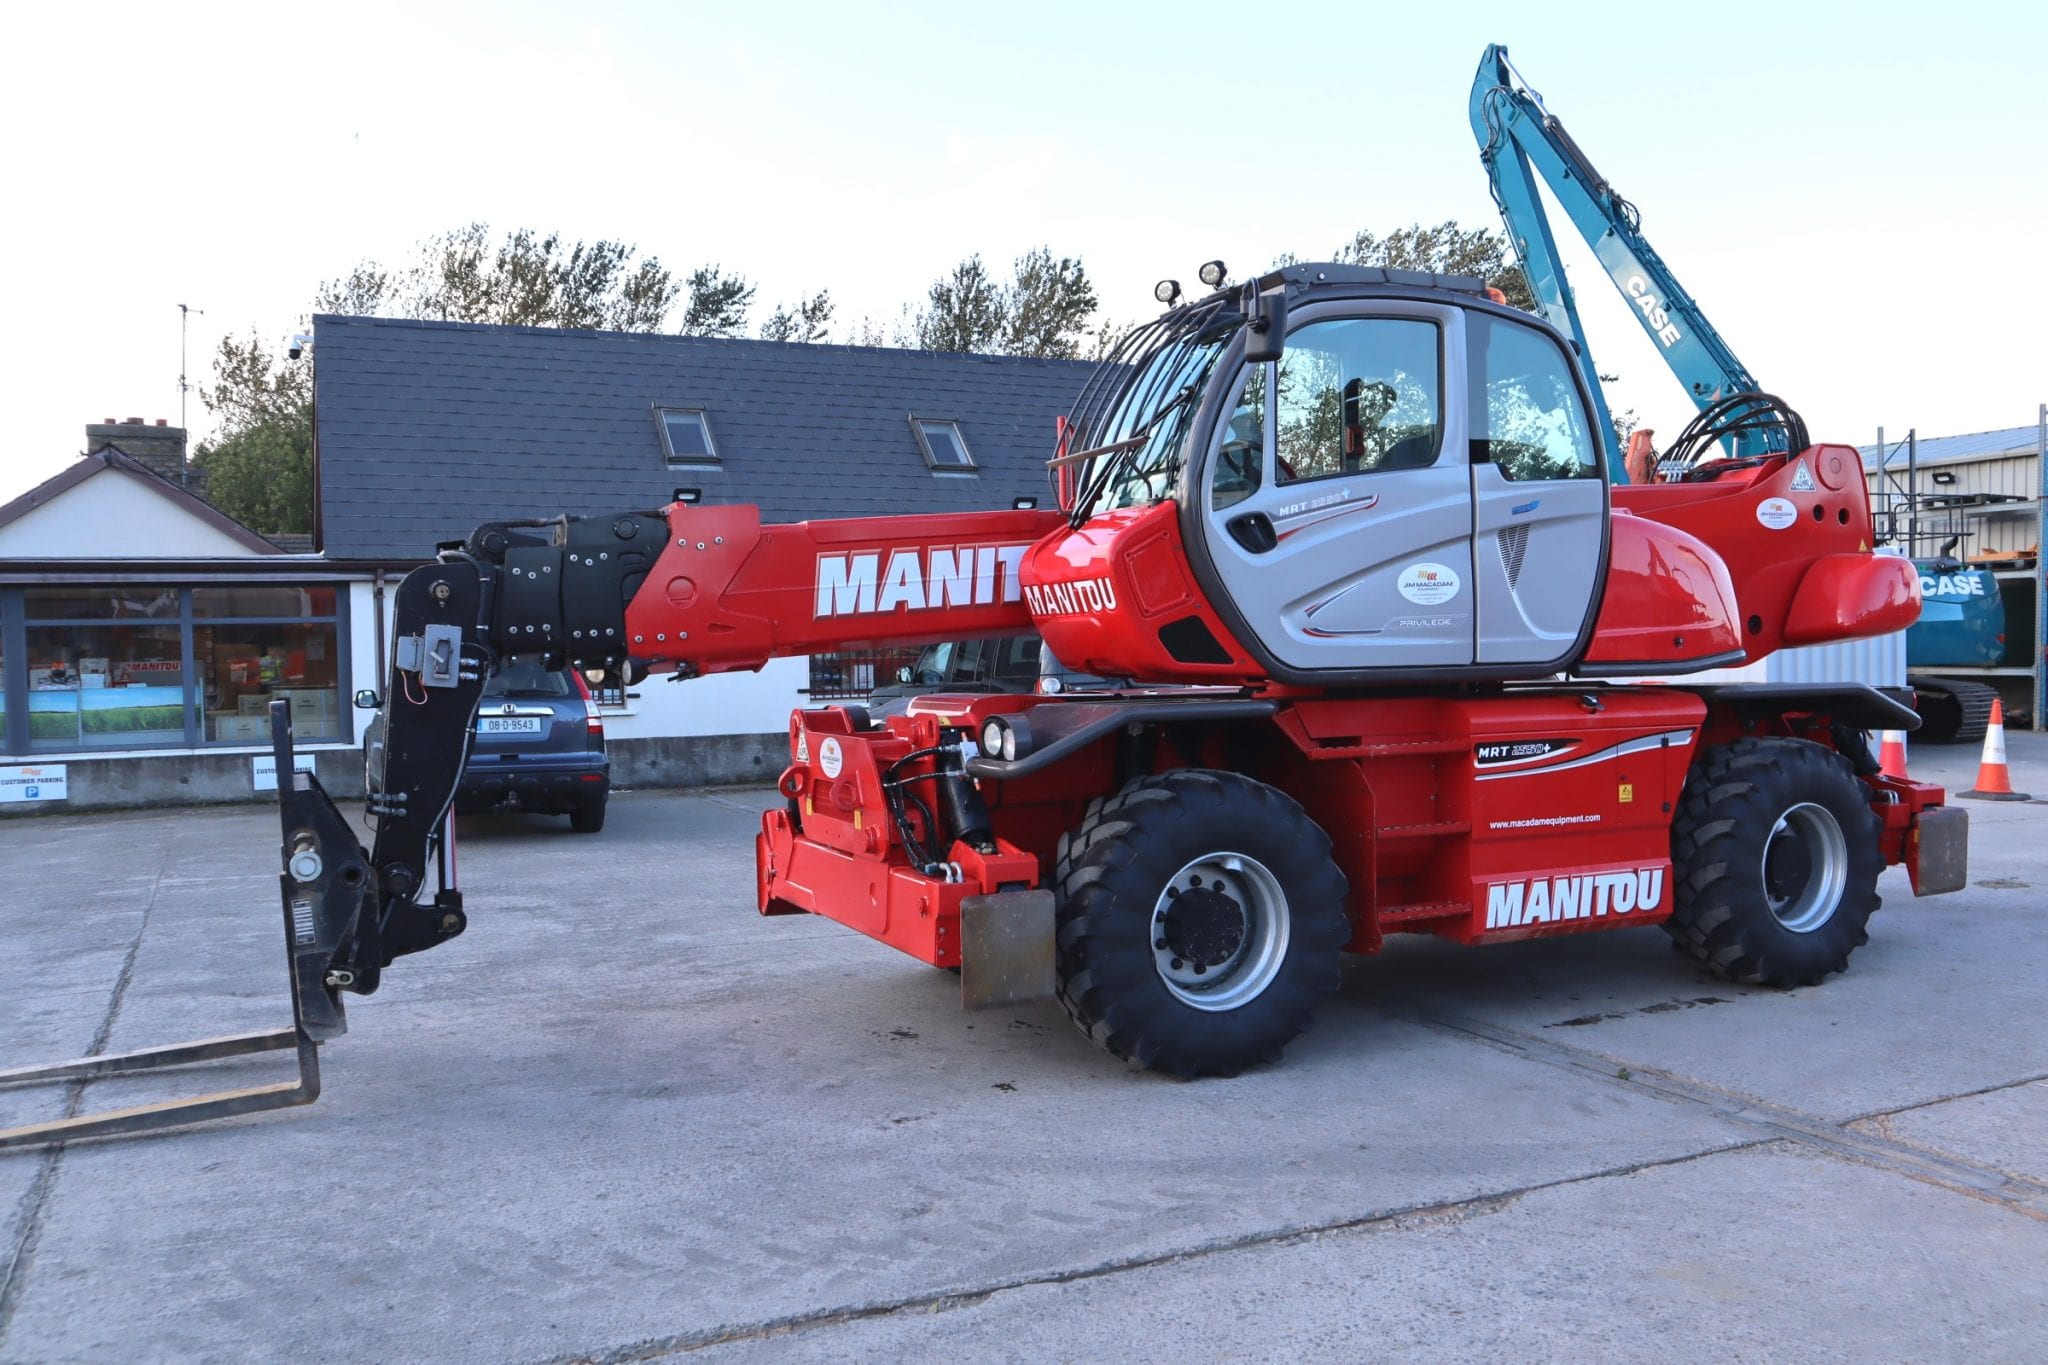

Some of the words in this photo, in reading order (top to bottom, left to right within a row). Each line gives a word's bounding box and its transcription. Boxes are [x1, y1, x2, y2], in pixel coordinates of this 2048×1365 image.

[1627, 275, 1682, 348] CASE
[1279, 501, 1308, 516] MRT
[814, 542, 1030, 620] MANIT
[1919, 575, 1985, 597] CASE
[1023, 577, 1117, 616] MANITOU
[1399, 618, 1453, 628] PRIVILEGE
[130, 661, 180, 672] MANITOU
[1477, 745, 1510, 759] MRT
[1489, 813, 1601, 830] www.macadamequipment.com
[1485, 867, 1665, 930] MANITOU
